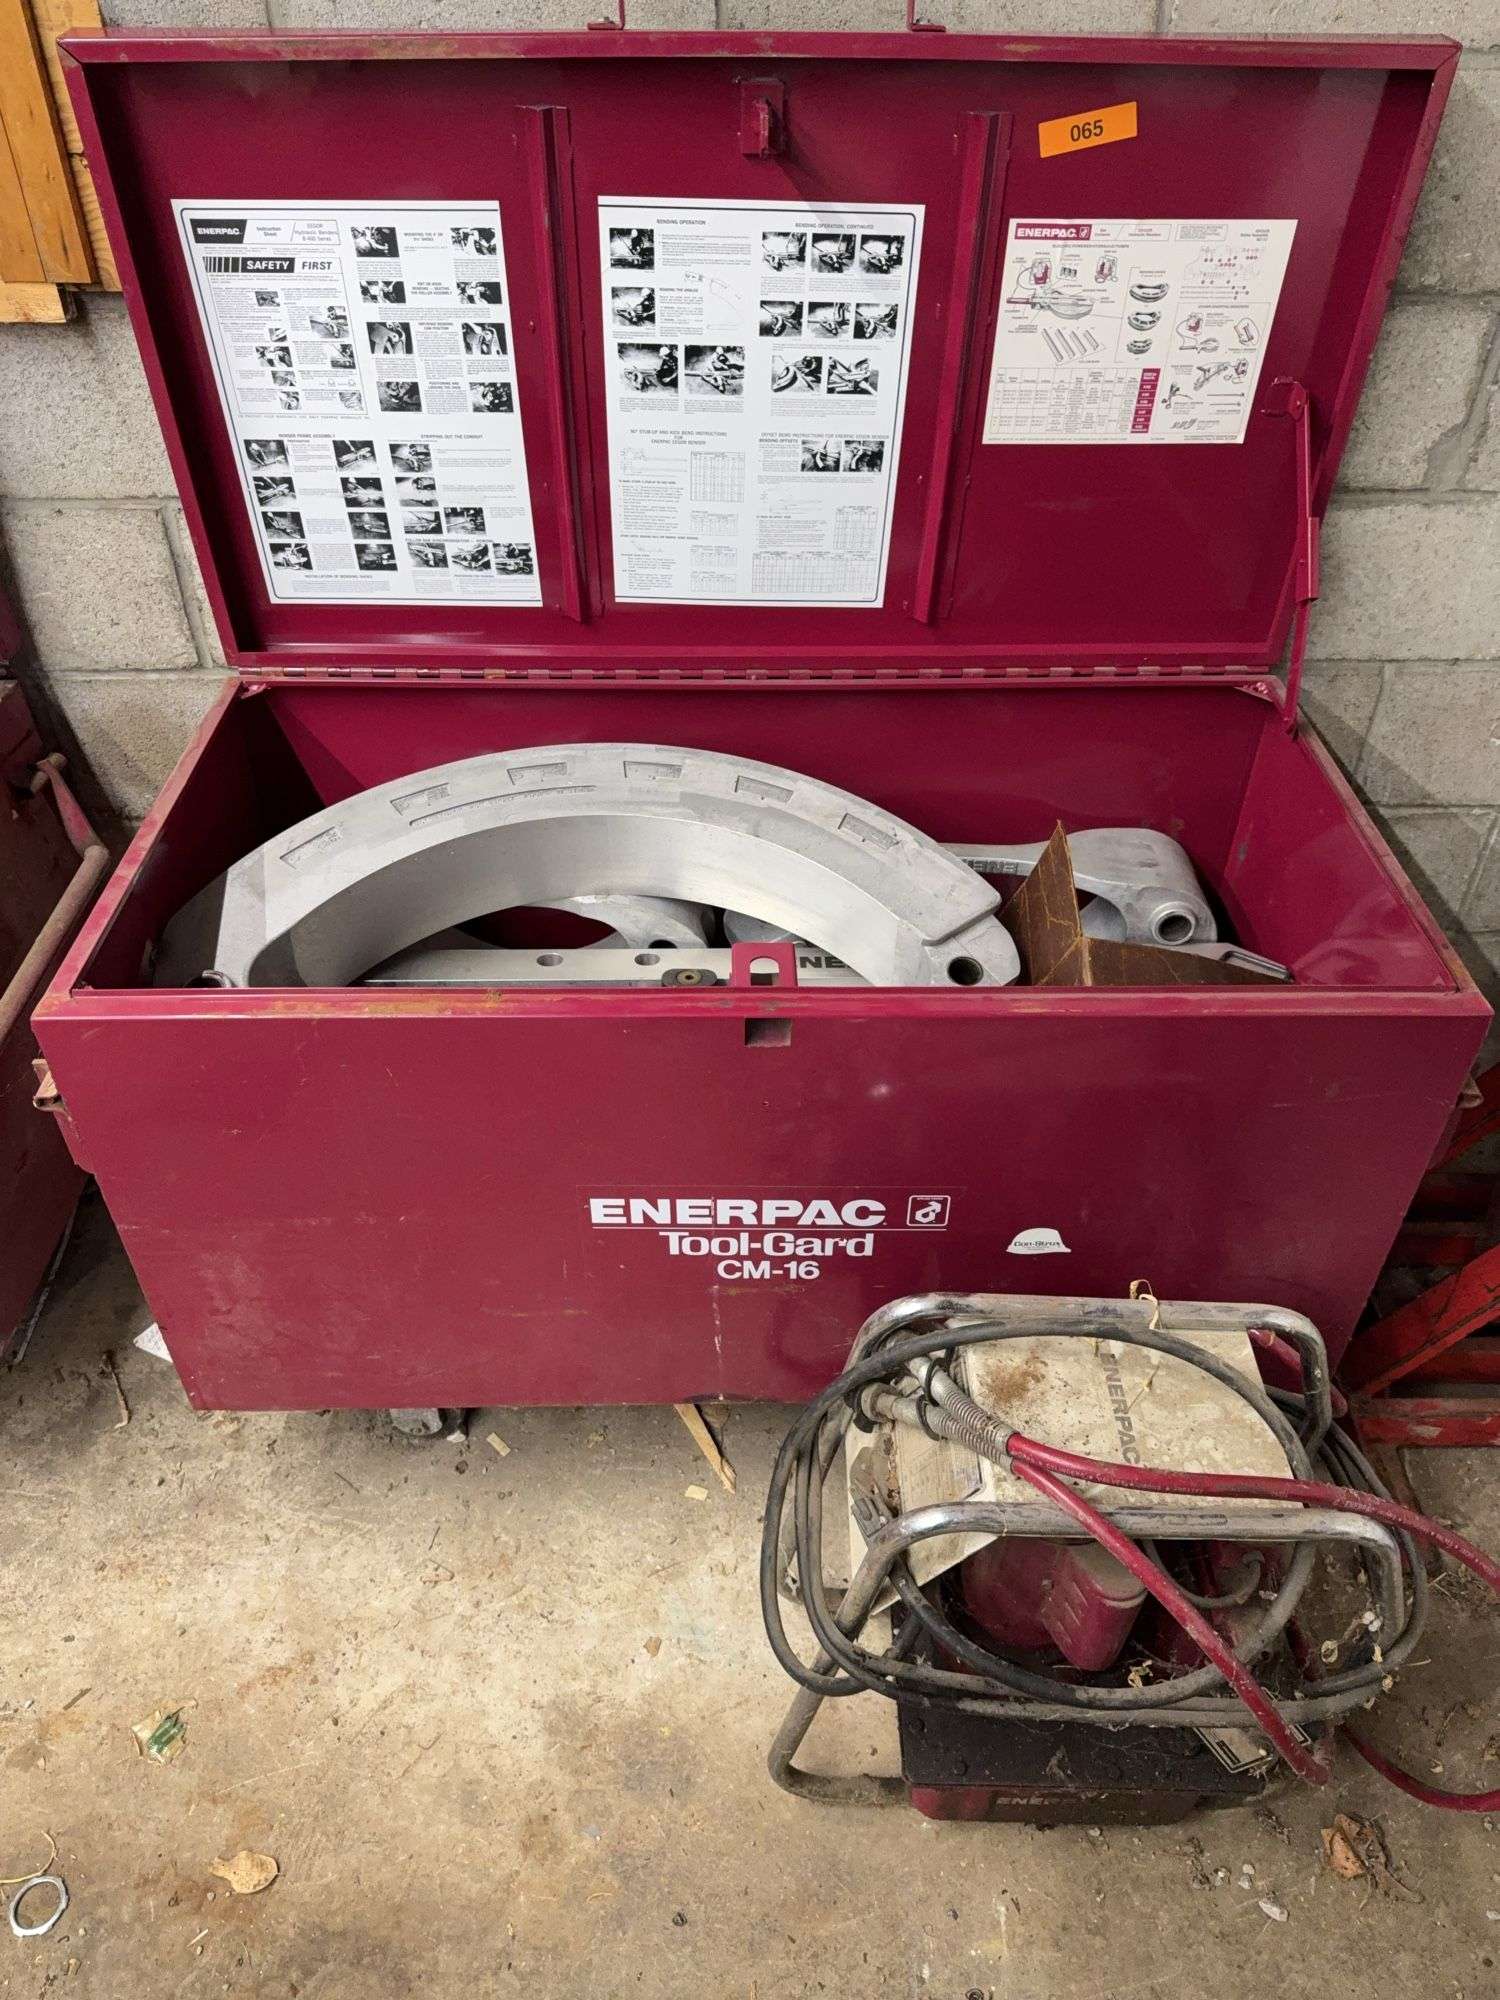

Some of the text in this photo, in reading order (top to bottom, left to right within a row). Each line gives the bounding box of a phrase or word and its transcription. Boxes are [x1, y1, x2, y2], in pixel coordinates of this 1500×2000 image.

[1069, 118, 1104, 143] 065
[196, 227, 240, 235] ENERPAC
[1016, 227, 1077, 238] ENERPAC
[246, 260, 333, 271] SAFETY FIRST
[589, 1197, 887, 1227] ENERPAC
[658, 1231, 875, 1258] Tool-Gard
[716, 1258, 820, 1281] CM-16
[1098, 1352, 1142, 1465] ENERPAC
